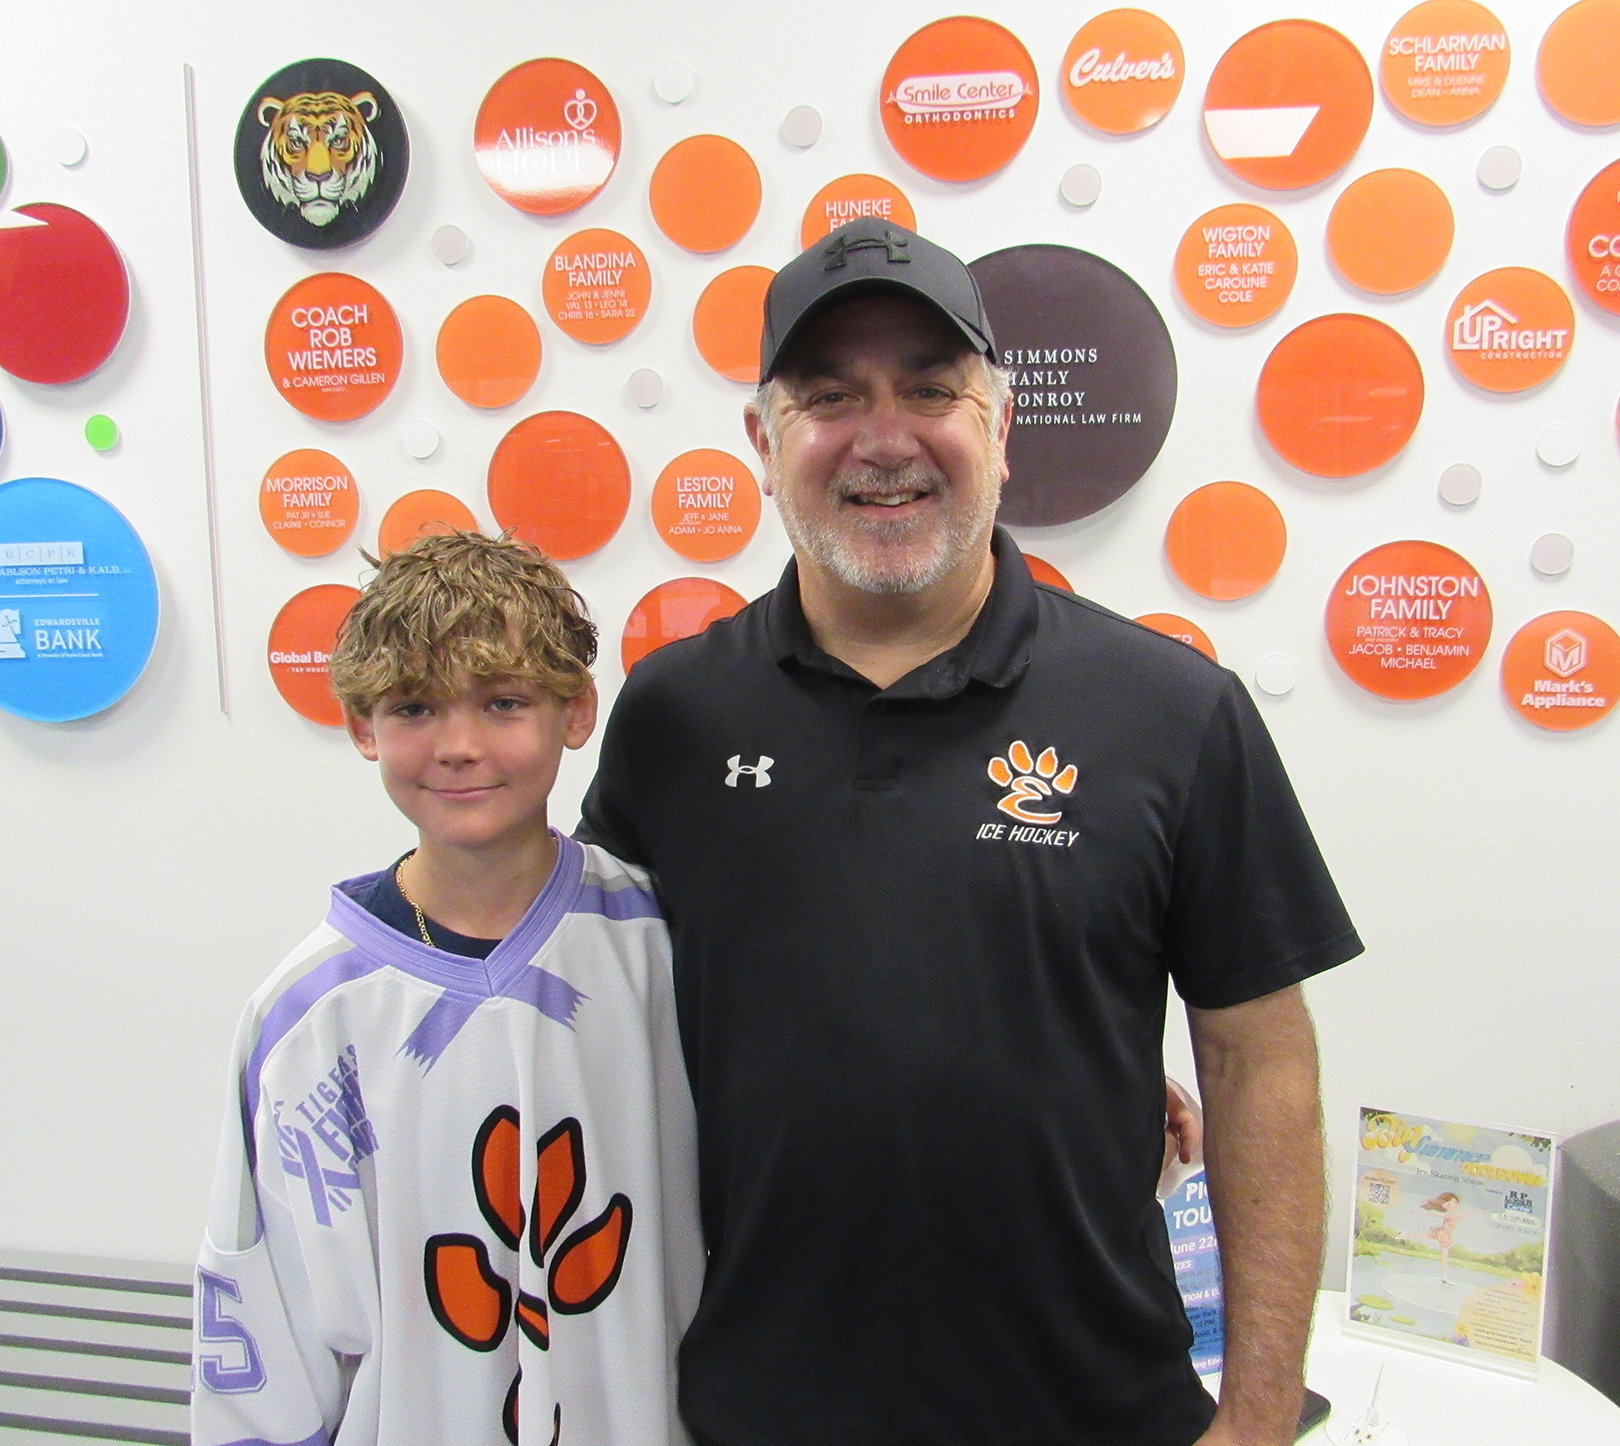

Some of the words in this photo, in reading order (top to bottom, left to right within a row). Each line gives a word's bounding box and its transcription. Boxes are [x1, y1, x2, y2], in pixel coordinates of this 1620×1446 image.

[1389, 34, 1505, 56] SCHLARMAN
[1069, 48, 1174, 87] Culver's
[1414, 53, 1480, 73] FAMILY
[1407, 76, 1430, 87] MIKE
[904, 83, 951, 101] Smile
[957, 81, 1014, 99] Center
[904, 108, 1015, 124] ORTHODONTICS
[825, 199, 892, 217] HUNEKE
[1202, 225, 1270, 243] WIGTON
[1208, 241, 1264, 258] FAMILY
[555, 252, 636, 271] BLANDINA
[1197, 264, 1226, 276] ERIC
[1229, 263, 1239, 275] &
[1242, 262, 1274, 275] KATIE
[568, 270, 623, 287] FAMILY
[1204, 276, 1267, 290] CAROLINE
[567, 291, 591, 301] JOHN
[592, 291, 600, 299] &
[601, 289, 626, 300] JENNI
[1218, 290, 1252, 303] COLE
[565, 301, 581, 310] VAL
[584, 300, 592, 310] 13
[599, 299, 616, 309] LEO
[618, 299, 628, 308] 14
[291, 304, 368, 328] COACH
[558, 311, 583, 320] CHRIS
[601, 309, 623, 318] SARA
[625, 308, 636, 318] 22
[310, 327, 352, 348] ROB
[287, 347, 377, 371] WIEMERS
[1004, 348, 1098, 365] SIMMONS
[1480, 351, 1563, 360] CONSTRUCTION
[282, 377, 291, 389] &
[293, 375, 348, 388] CAMERON
[350, 373, 385, 386] GILLEN
[1012, 391, 1086, 407] ONROY
[1016, 414, 1076, 425] NATIONAL
[1081, 413, 1107, 424] LAW
[1112, 412, 1142, 424] FIRM
[266, 476, 348, 492] MORRISON
[677, 476, 734, 492] LESTON
[283, 492, 333, 508] FAMILY
[678, 493, 733, 508] FAMILY
[681, 513, 699, 522] JEFF
[707, 512, 729, 522] JANE
[669, 526, 696, 535] ADAM
[703, 526, 715, 535] JO
[717, 525, 743, 534] ANNA
[44, 566, 75, 575] PETRI
[78, 566, 86, 575] &
[1345, 574, 1478, 597] JOHNSTON
[1370, 599, 1453, 620] FAMILY
[34, 618, 100, 627] EDWARDSVILLE
[35, 629, 102, 650] BANK
[1356, 626, 1407, 638] PATRICK
[1409, 626, 1419, 638] &
[1423, 627, 1465, 639] TRACY
[270, 651, 312, 664] Global
[1348, 643, 1393, 655] JACOB
[1405, 644, 1470, 656] BENJAMIN
[1380, 657, 1437, 669] MICHAEL
[1534, 680, 1594, 693] Mark's
[1521, 693, 1606, 709] Appliance
[976, 823, 1007, 840] ICE
[1008, 825, 1080, 847] HOCKEY
[1186, 1181, 1208, 1202] PI
[191, 1264, 267, 1394] 5
